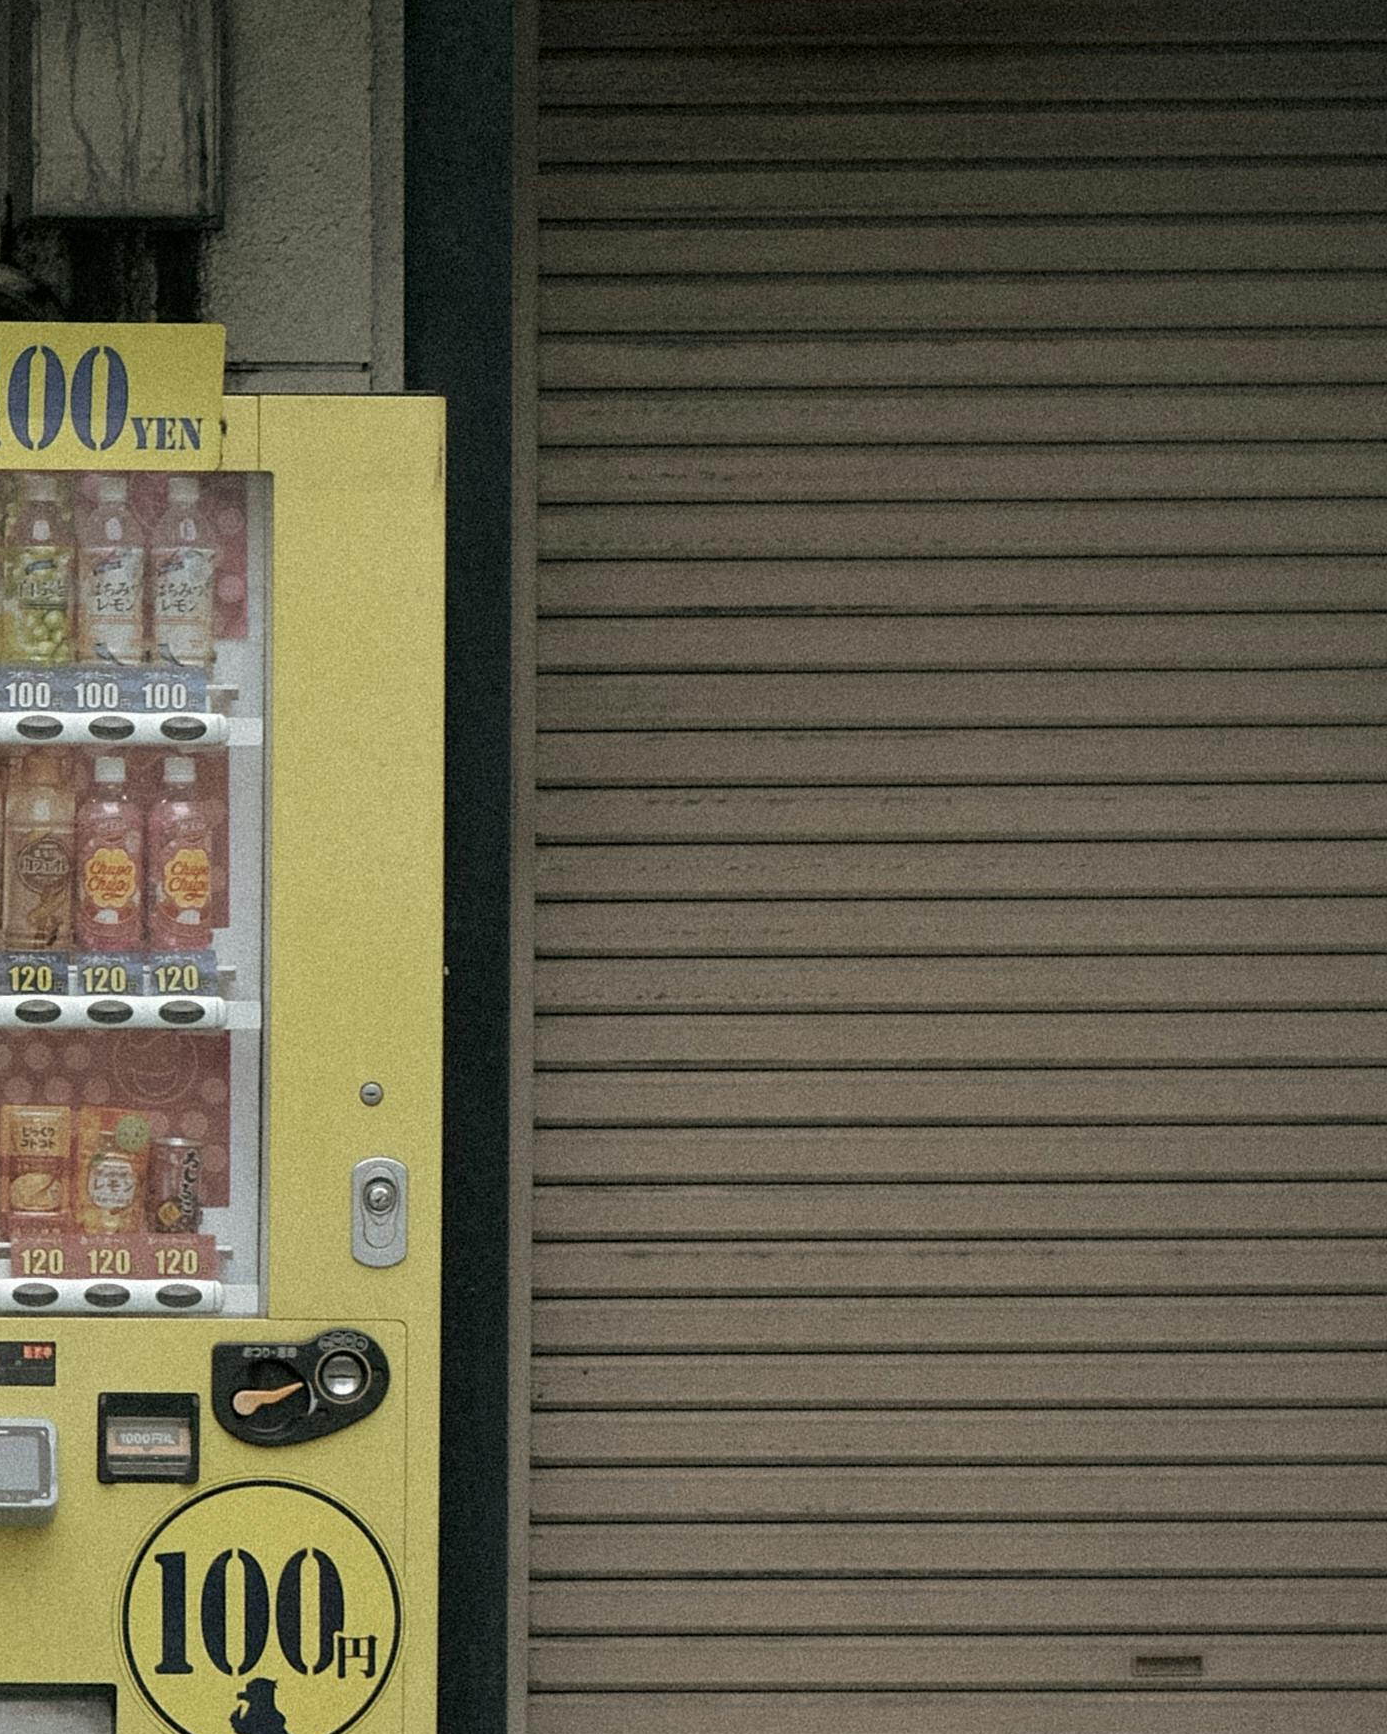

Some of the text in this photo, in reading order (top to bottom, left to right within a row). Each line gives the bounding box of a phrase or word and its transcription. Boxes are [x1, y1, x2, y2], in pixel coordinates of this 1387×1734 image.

[131, 417, 204, 451] YEN
[96, 598, 134, 612] レモン
[161, 599, 198, 613] レモン
[154, 1548, 378, 1679] 100円
